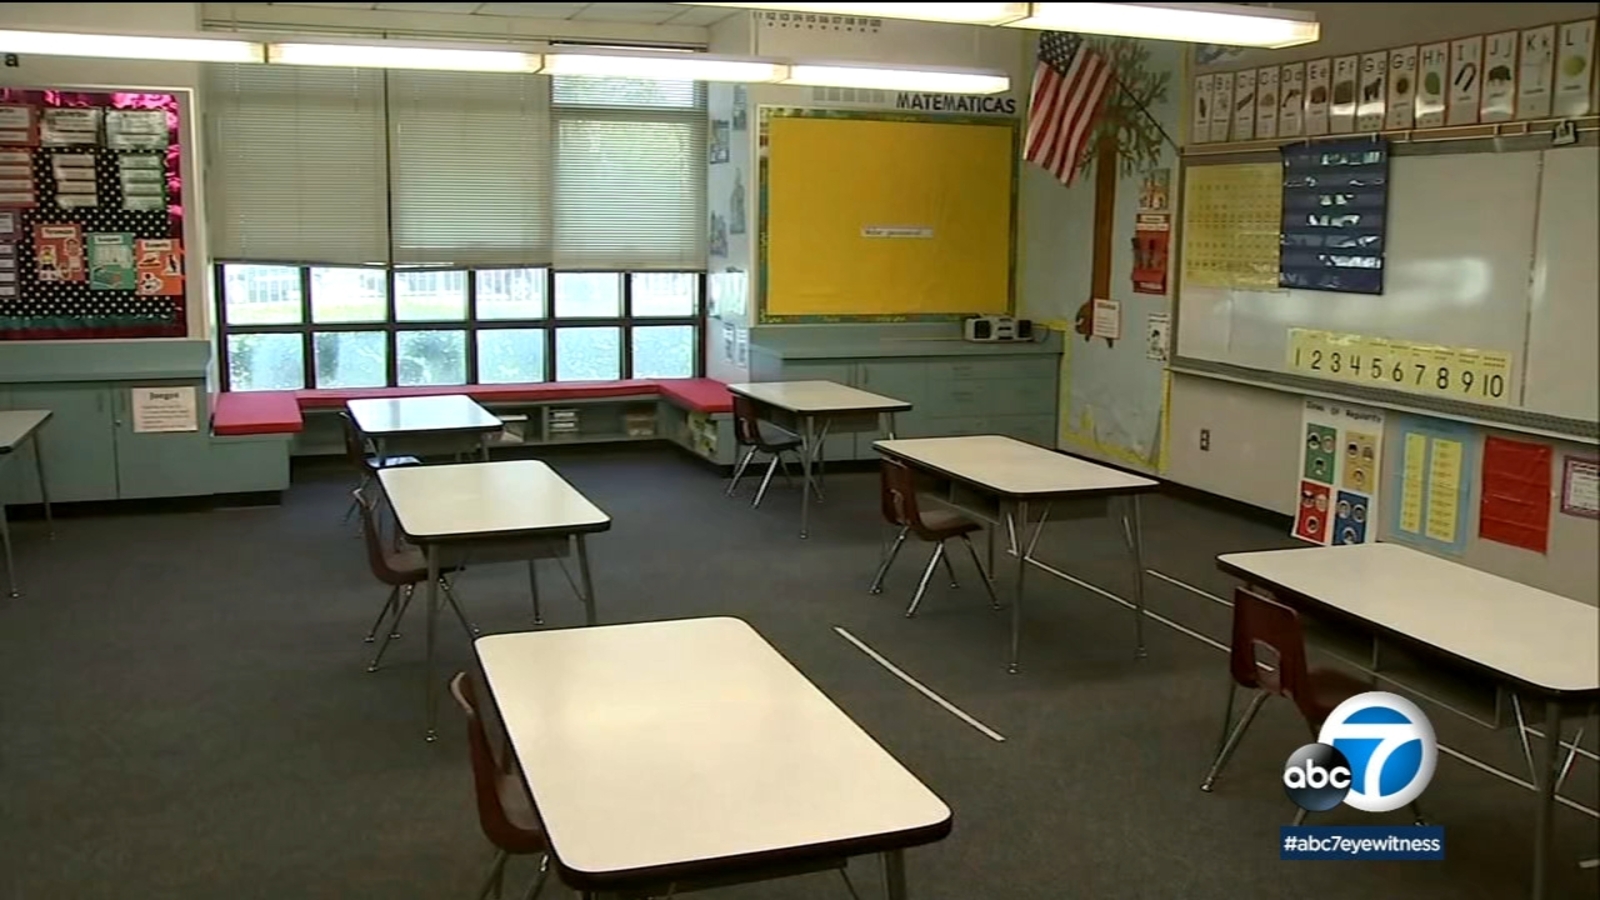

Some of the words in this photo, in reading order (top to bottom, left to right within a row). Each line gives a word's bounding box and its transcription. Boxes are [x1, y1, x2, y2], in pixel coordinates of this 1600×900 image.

[5, 52, 20, 68] a
[896, 91, 1016, 114] MATEMATICAS
[1294, 347, 1301, 367] 1
[1310, 349, 1322, 370] 2
[1330, 352, 1341, 373] 3
[1350, 354, 1361, 376] 4
[1371, 357, 1382, 379] 5
[1392, 360, 1404, 382] 6
[1415, 364, 1426, 386] 7
[1436, 367, 1449, 390] 8
[1461, 370, 1474, 393] 9
[1483, 374, 1504, 398] 10
